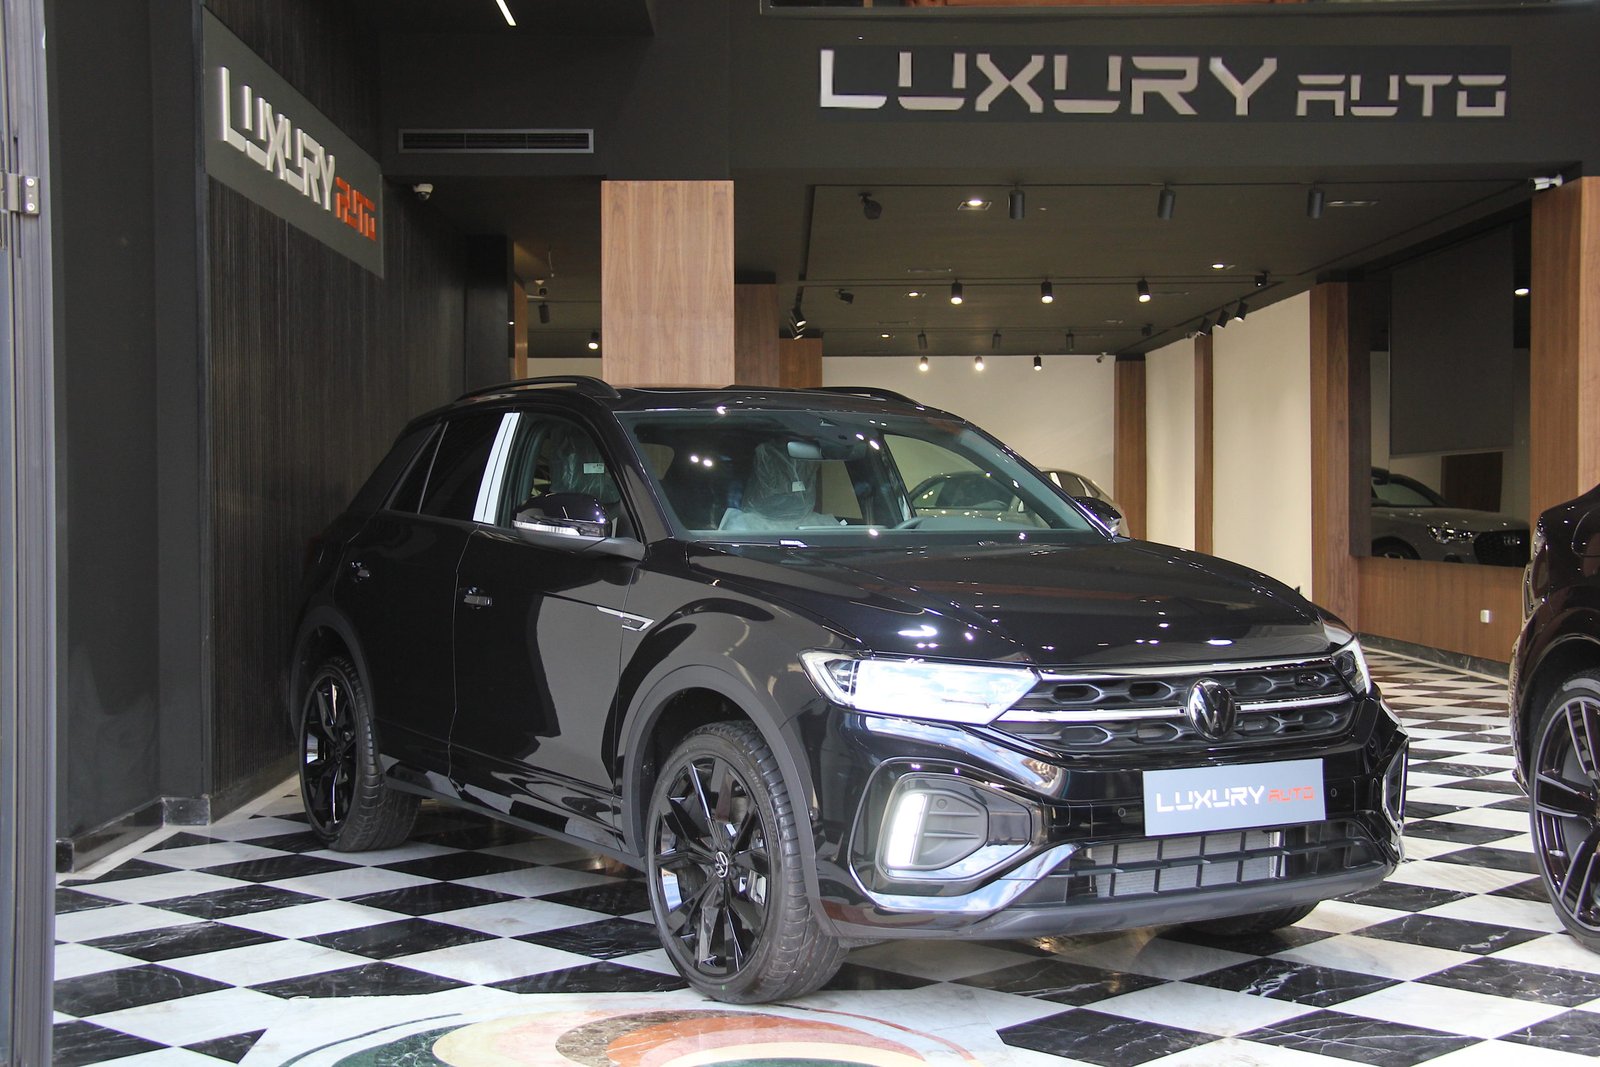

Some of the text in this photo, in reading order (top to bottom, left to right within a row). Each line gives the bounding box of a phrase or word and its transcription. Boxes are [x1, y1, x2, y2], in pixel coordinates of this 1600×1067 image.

[819, 48, 1507, 117] LUXURY AUTO
[220, 66, 336, 212] LUXURY
[1156, 785, 1315, 813] LUXURY AUTO
